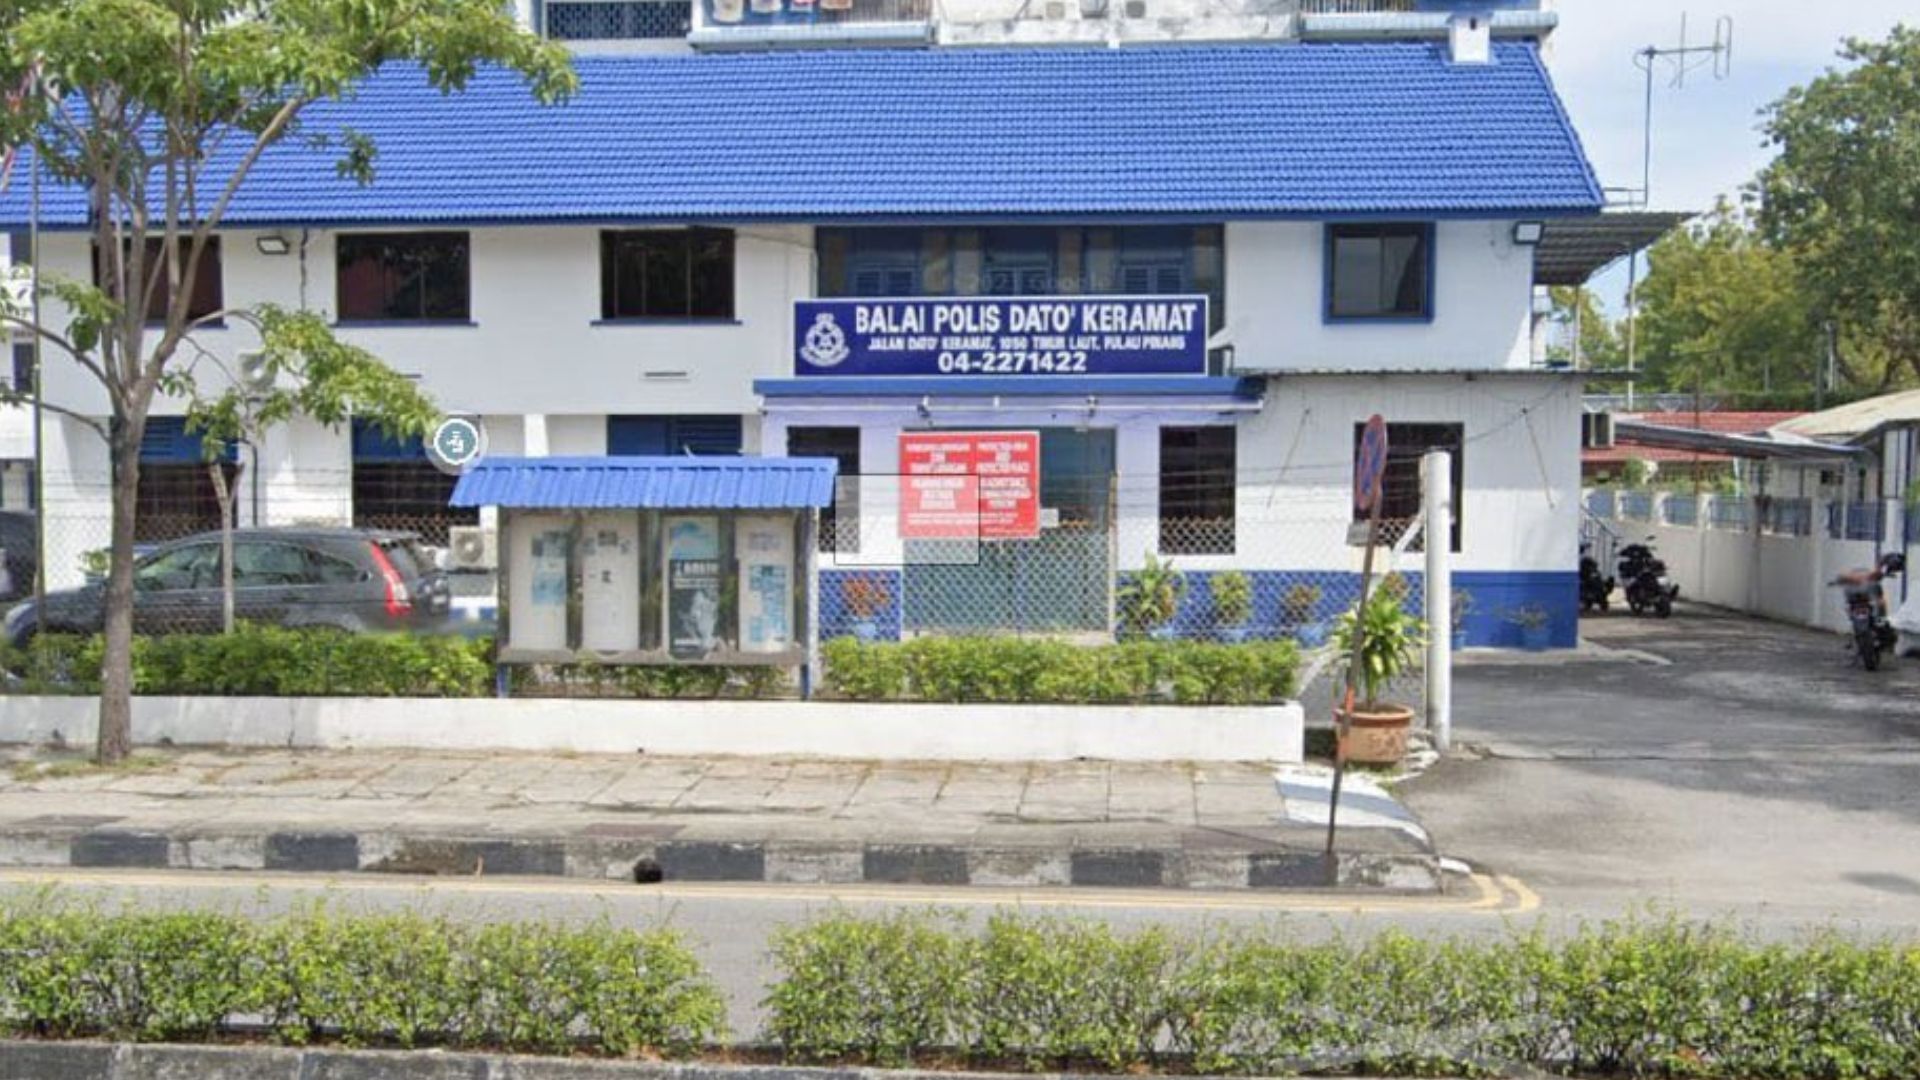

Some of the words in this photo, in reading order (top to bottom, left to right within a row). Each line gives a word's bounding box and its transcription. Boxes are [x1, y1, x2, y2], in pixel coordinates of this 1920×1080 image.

[855, 304, 925, 333] BALAI
[933, 304, 1000, 333] POLIS
[1009, 304, 1076, 333] DATO'
[1082, 304, 1198, 332] KERAMAT
[868, 336, 904, 350] JALAN
[937, 351, 1087, 373] 04-2271422
